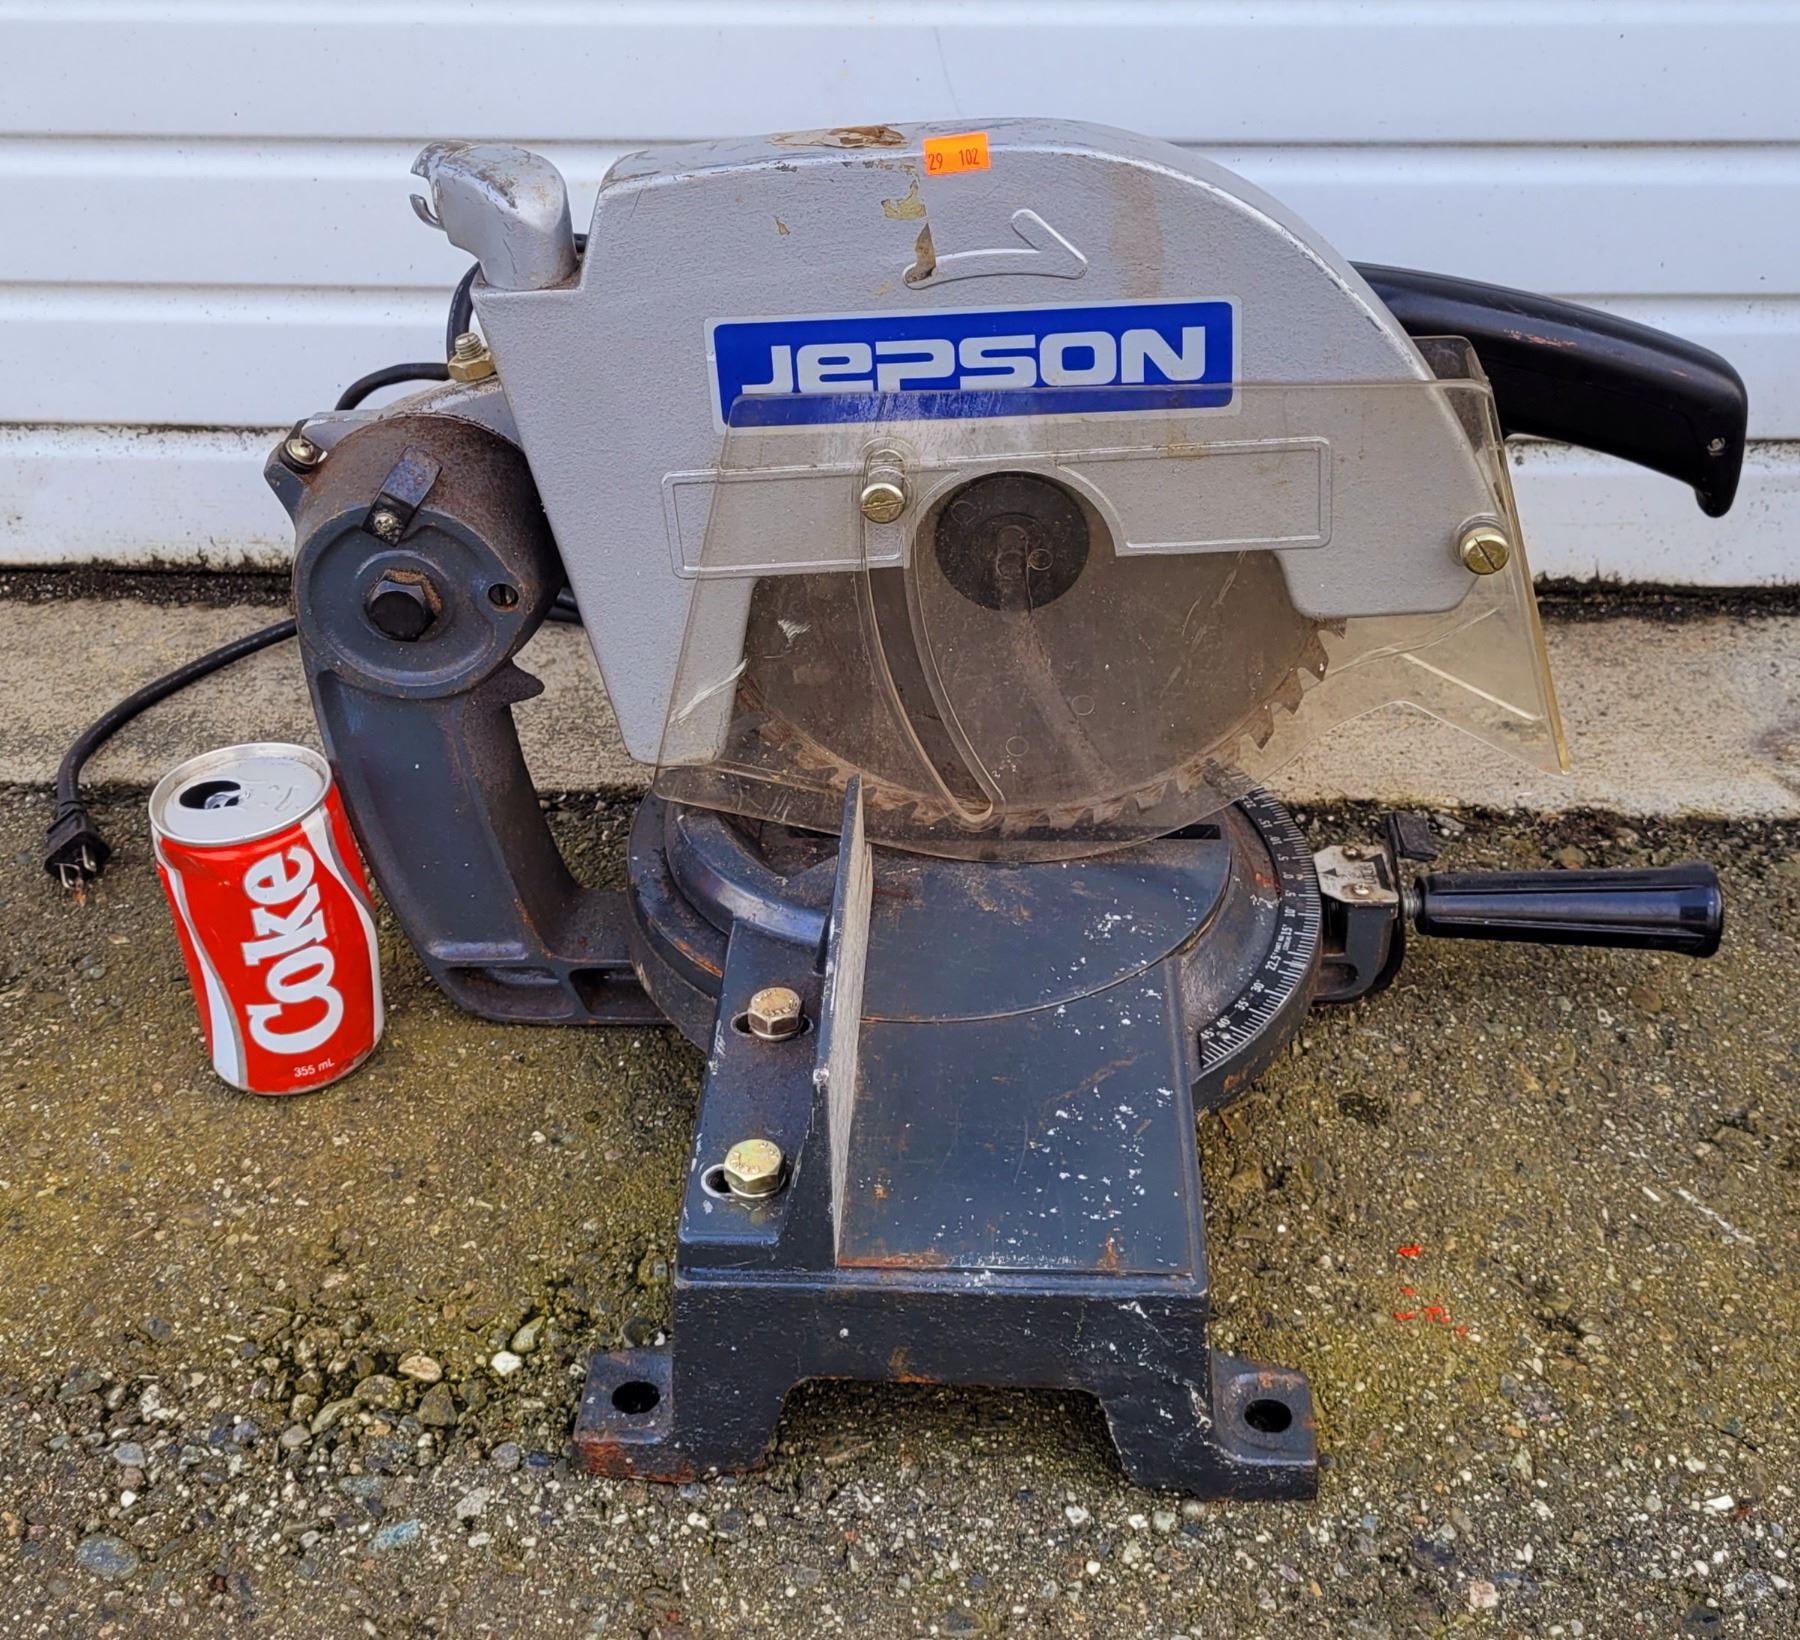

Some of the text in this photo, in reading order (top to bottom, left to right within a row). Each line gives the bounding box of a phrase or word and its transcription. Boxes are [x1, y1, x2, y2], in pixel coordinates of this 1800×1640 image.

[928, 147, 980, 171] 29 102
[242, 845, 344, 1055] Coke
[293, 1057, 336, 1078] 355 mL
